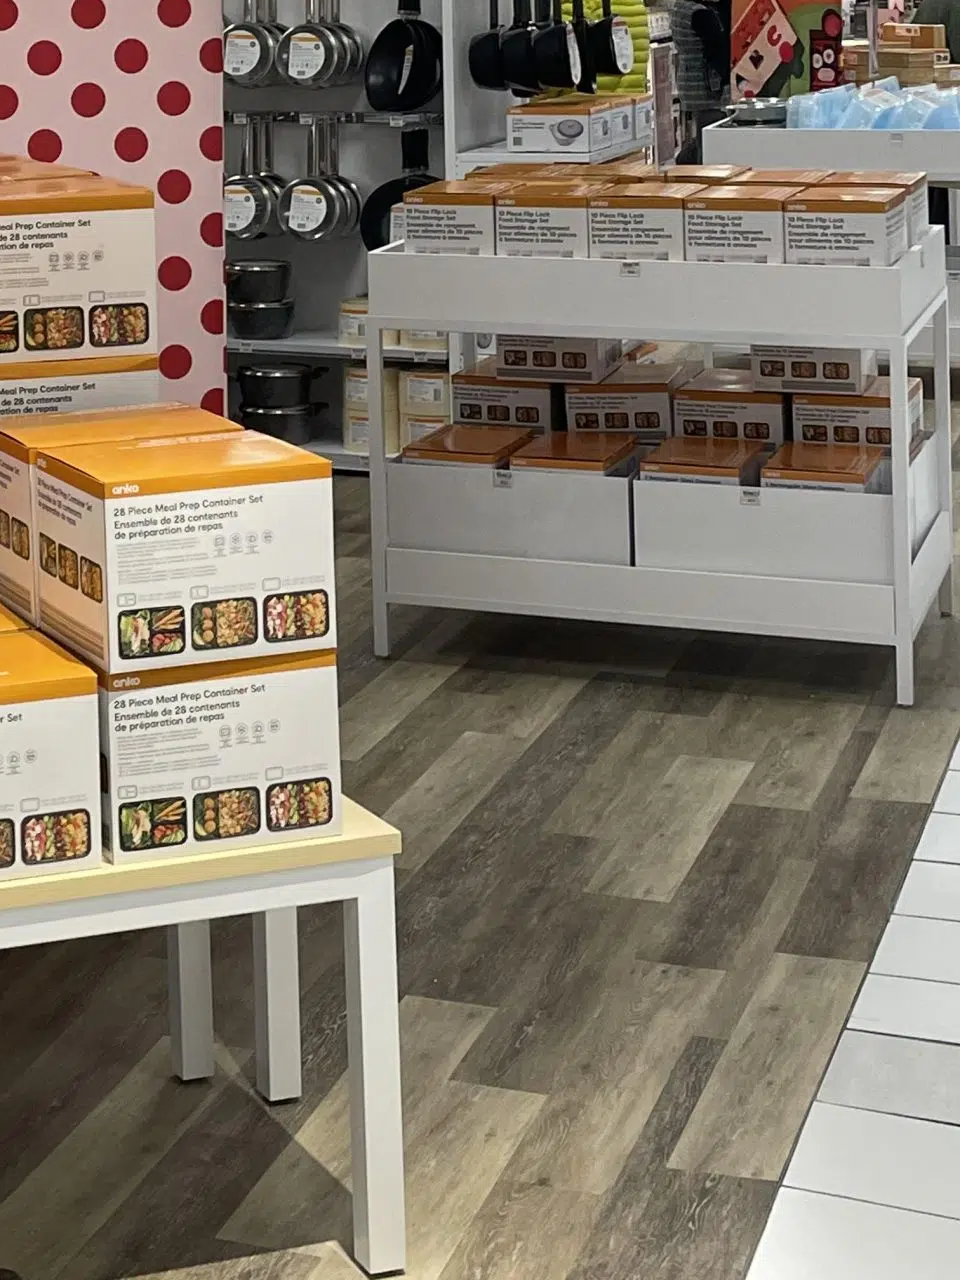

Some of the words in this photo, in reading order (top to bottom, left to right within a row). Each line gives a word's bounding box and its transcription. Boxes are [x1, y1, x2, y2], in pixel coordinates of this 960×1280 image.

[112, 483, 139, 495] anko
[114, 508, 126, 517] 28
[128, 507, 153, 515] Piece
[155, 503, 177, 513] Meal
[179, 501, 200, 510] Prep
[202, 497, 246, 508] Container
[248, 495, 263, 504] Set
[114, 518, 158, 530] Ensemble
[160, 516, 172, 525] de
[174, 514, 186, 524] 28
[187, 510, 238, 522] contenants
[114, 531, 126, 540] de
[128, 527, 182, 540] préparation
[184, 524, 196, 533] de
[198, 523, 223, 532] repas
[113, 676, 140, 688] anko
[114, 700, 126, 709] 28
[128, 698, 154, 708] Piece
[156, 694, 178, 704] Meal
[180, 692, 201, 702] Prep
[203, 687, 248, 699] Container
[250, 684, 265, 693] Set
[7, 713, 22, 722] Set
[114, 709, 159, 722] Ensemble
[161, 708, 172, 717] de
[175, 705, 187, 715] 28
[189, 701, 240, 713] contenants
[114, 723, 127, 732] de
[129, 718, 183, 733] préparation
[185, 715, 197, 724] de
[199, 713, 225, 723] repas
